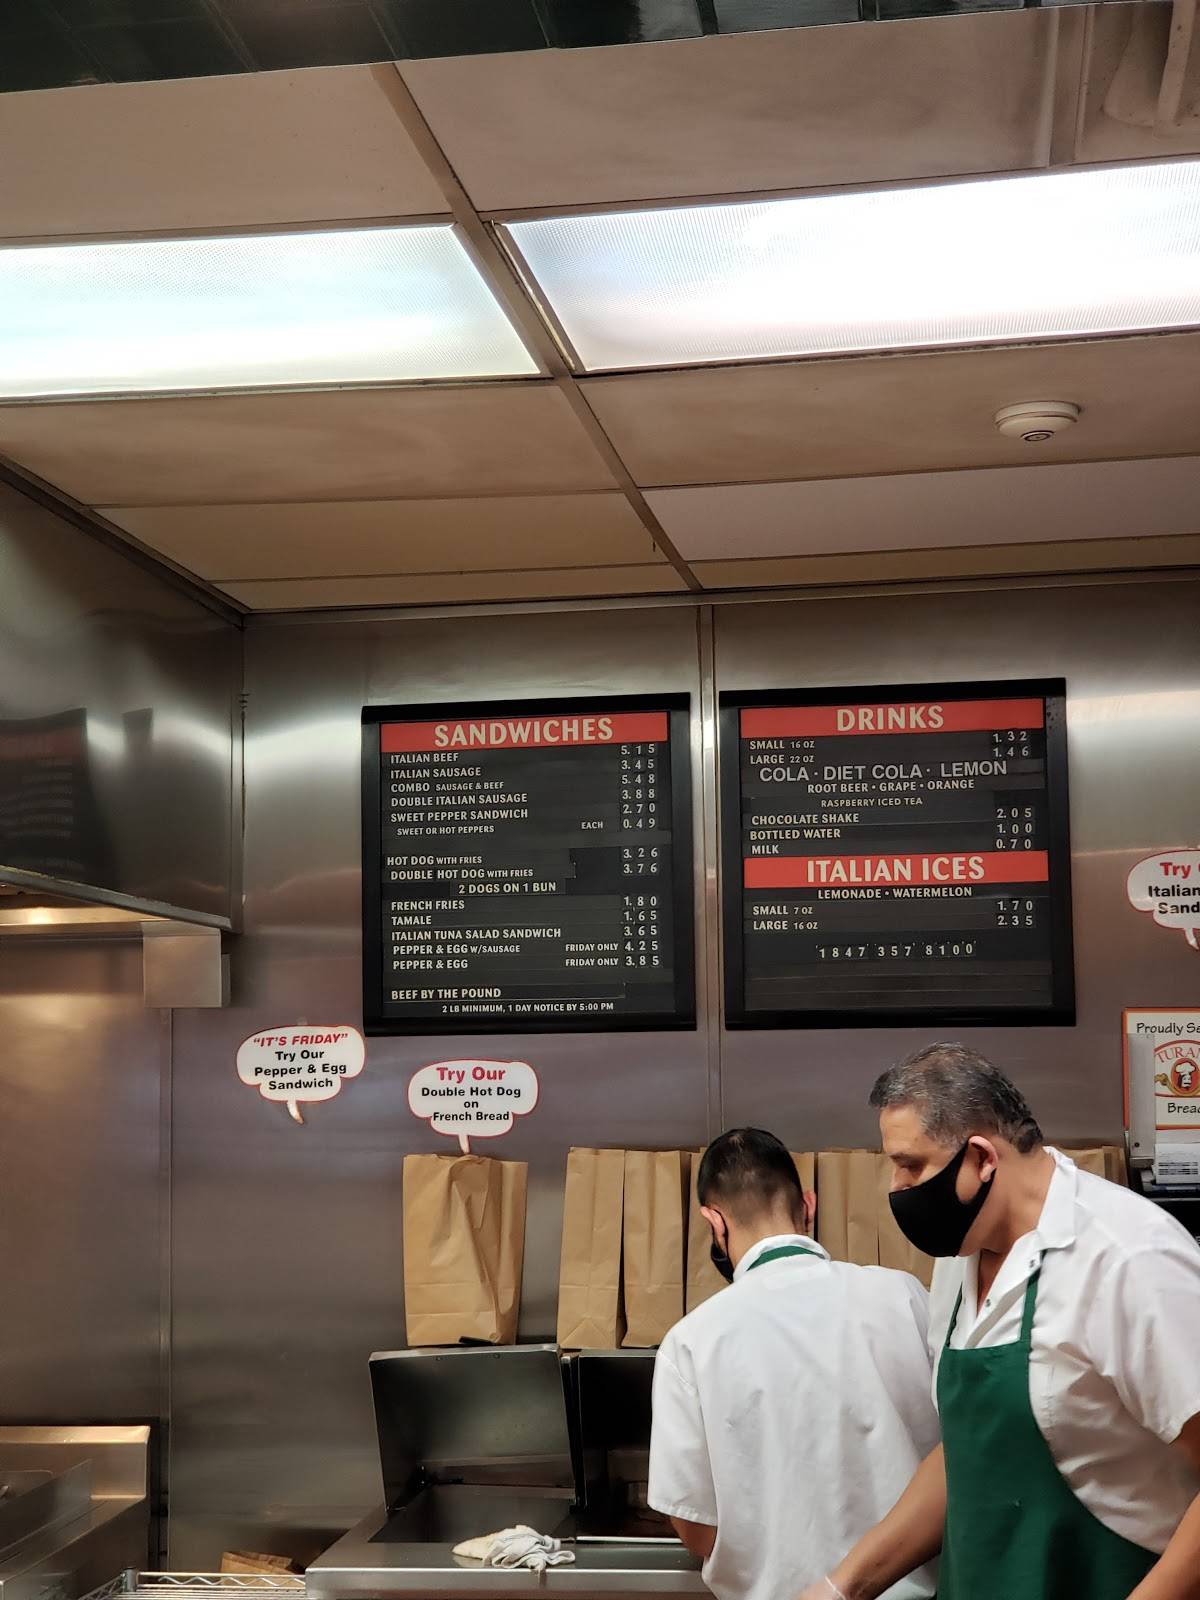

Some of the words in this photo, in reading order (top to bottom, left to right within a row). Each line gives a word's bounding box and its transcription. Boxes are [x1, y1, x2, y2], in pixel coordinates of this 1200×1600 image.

[836, 705, 944, 732] DRINKS
[434, 717, 613, 747] SANDWICHES
[750, 741, 785, 750] SMALL
[790, 741, 801, 749] 16
[804, 740, 814, 749] OZ
[391, 754, 431, 764] ITALIAN
[433, 753, 459, 763] BEEF
[750, 755, 784, 764] LARGE
[789, 755, 800, 763] 22
[803, 755, 814, 763] OZ
[390, 769, 431, 779] ITALIAN
[433, 767, 481, 778] SAUSAGE
[759, 767, 809, 782] COLA
[823, 766, 865, 781] DIET
[872, 764, 922, 780] COLA
[940, 761, 1007, 778] LEMON
[391, 783, 430, 793] COMBO
[436, 783, 473, 791] SAUSAGE
[475, 782, 482, 790] &
[484, 781, 504, 789] BEEF
[807, 784, 837, 794] ROOT
[840, 783, 868, 793] BEER
[879, 782, 916, 792] GRAPE
[928, 779, 974, 790] ORANGE
[391, 796, 433, 807] DOUBLE
[436, 795, 476, 805] ITALIAN
[478, 793, 527, 804] SAUSAGE
[821, 799, 875, 808] RASPBERRY
[877, 798, 901, 806] ICED
[904, 797, 922, 805] TEA
[391, 812, 425, 823] SWEET
[427, 811, 468, 821] PEPPER
[470, 809, 528, 820] SANDWICH
[751, 815, 818, 825] CHOCOLATE
[822, 813, 859, 824] SHAKE
[397, 827, 423, 836] SWEET
[425, 827, 437, 835] OR
[458, 825, 494, 834] PEPPERS
[581, 821, 603, 829] EACH
[750, 830, 800, 840] BOTTLED
[804, 829, 841, 839] WATER
[752, 845, 779, 854] MILK
[387, 856, 408, 865] HOT
[410, 856, 434, 865] DOG
[436, 856, 457, 864] WITH
[460, 856, 482, 864] FRIES
[391, 870, 433, 881] DOUBLE
[437, 869, 459, 879] HOT
[461, 869, 485, 879] DOG
[487, 869, 508, 877] WITH
[510, 869, 533, 877] FRIES
[807, 859, 912, 883] ITALIAN
[922, 855, 984, 881] ICES
[1160, 862, 1191, 879] Try
[459, 884, 465, 894] 2
[469, 883, 500, 893] DOGS
[503, 883, 519, 892] ON
[523, 883, 528, 892] 1
[533, 882, 557, 892] BUN
[818, 889, 881, 899] LEMONADE
[893, 887, 972, 898] WATERMELON
[391, 901, 432, 911] FRENCH
[435, 900, 465, 910] FRIES
[753, 906, 788, 915] SMALL
[794, 907, 799, 915] 7
[802, 906, 813, 915] OZ
[392, 915, 432, 925] TAMALE
[753, 920, 788, 931] LARGE
[793, 922, 804, 930] 16
[806, 922, 818, 930] OZ
[391, 931, 432, 941] ITALIAN
[434, 930, 462, 940] TUNA
[465, 929, 499, 939] SALAD
[503, 928, 561, 938] SANDWICH
[393, 945, 433, 955] PEPPER
[436, 945, 443, 954] &
[446, 944, 468, 954] EGG
[470, 944, 520, 954] W/SAUSAGE
[566, 943, 595, 952] FRIDAY
[597, 942, 618, 951] ONLY
[393, 960, 433, 970] PEPPER
[436, 960, 444, 969] &
[447, 959, 468, 969] EGG
[566, 958, 595, 966] FRIDAY
[597, 957, 618, 966] ONLY
[392, 989, 419, 1000] BEEF
[421, 989, 436, 999] BY
[438, 989, 458, 999] THE
[462, 988, 501, 998] POUND
[450, 1005, 460, 1013] LB
[462, 1004, 506, 1013] MINIMUM,
[533, 1003, 565, 1011] NOTICE
[566, 1003, 577, 1011] BY
[600, 1002, 614, 1010] PM
[1136, 1022, 1184, 1036] Proudly
[275, 1051, 295, 1062] Try
[300, 1049, 324, 1060] Our
[255, 1065, 302, 1077] Pepper
[308, 1065, 316, 1074] &
[322, 1064, 347, 1075] Egg
[436, 1067, 465, 1084] Try
[471, 1067, 506, 1080] Our
[268, 1079, 333, 1090] Sandwich
[421, 1087, 465, 1097] Double
[470, 1086, 492, 1096] Hot
[497, 1086, 521, 1098] Dog
[464, 1100, 479, 1108] on
[433, 1112, 472, 1121] French
[476, 1111, 510, 1121] Bread
